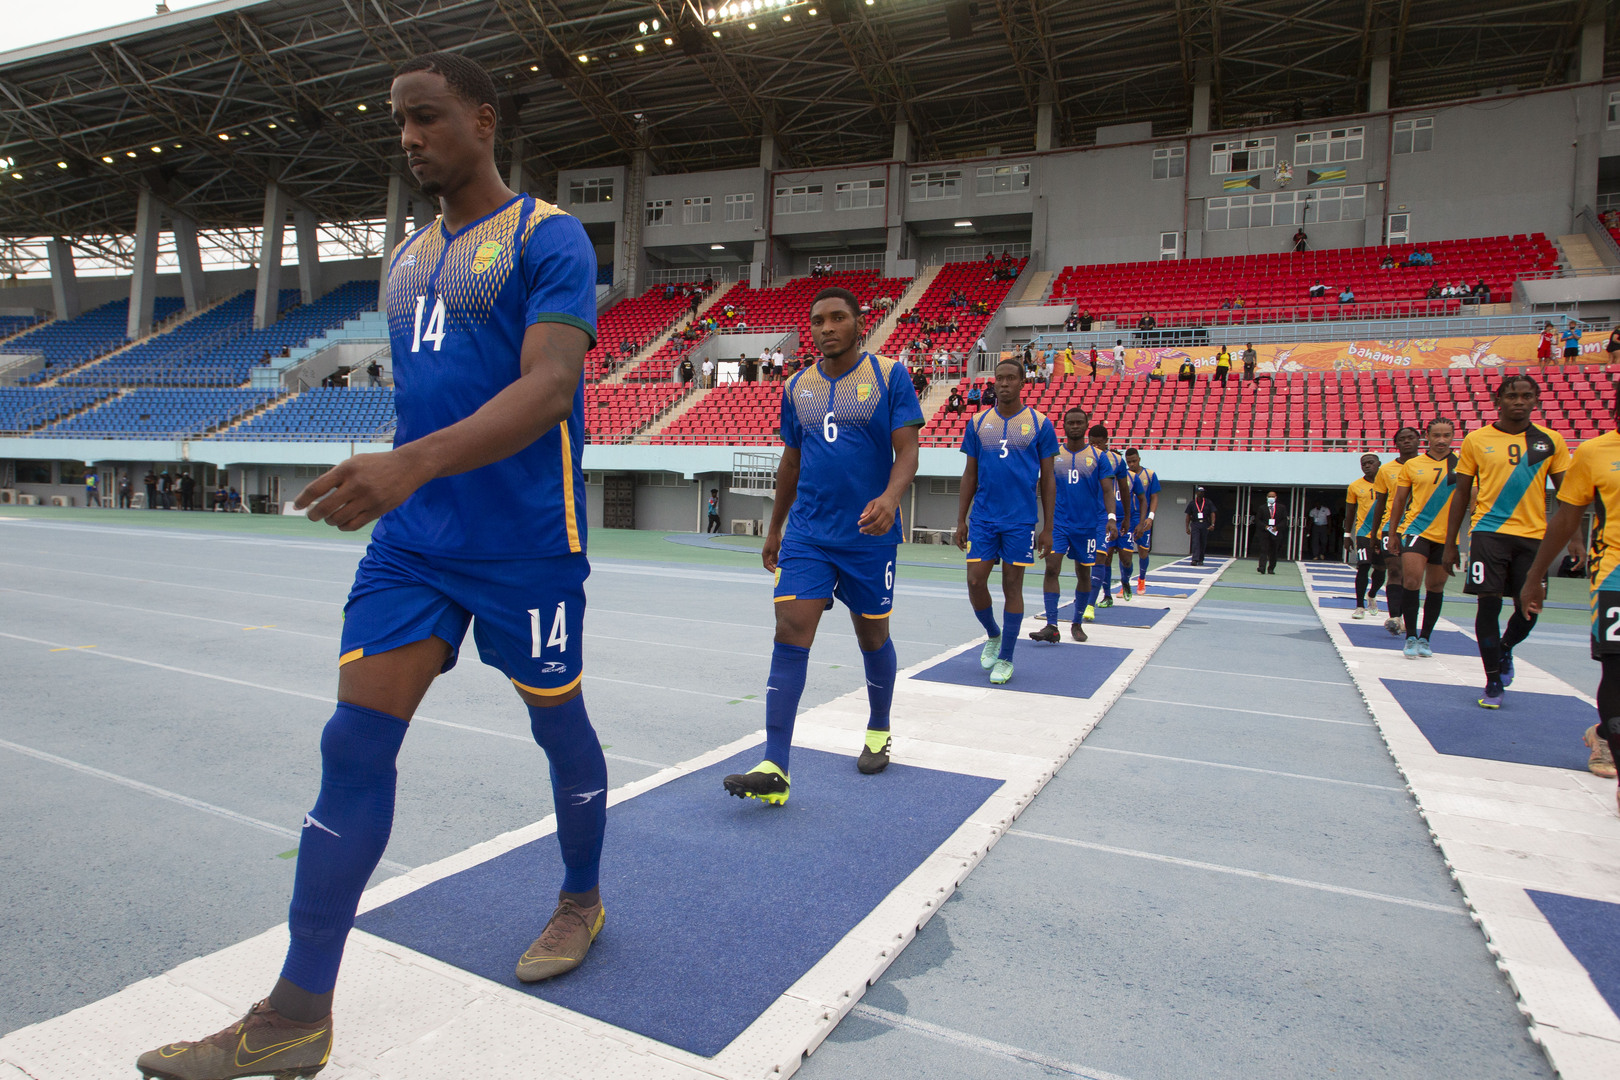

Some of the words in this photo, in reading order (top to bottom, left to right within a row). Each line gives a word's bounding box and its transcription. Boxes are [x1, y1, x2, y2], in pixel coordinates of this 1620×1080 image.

[411, 293, 447, 353] 14
[1184, 349, 1245, 368] ahaas
[1348, 342, 1411, 366] bahamas
[823, 411, 838, 443] 6
[1000, 439, 1009, 459] 3
[1508, 443, 1521, 466] 9
[1068, 469, 1079, 484] 19
[1433, 467, 1443, 485] 7
[1029, 530, 1036, 550] 3
[1086, 538, 1096, 554] 19
[1408, 533, 1420, 547] 7
[1357, 547, 1368, 561] 11
[884, 560, 893, 590] 6
[1472, 561, 1485, 585] 9
[527, 601, 568, 658] 14
[1606, 606, 1620, 642] 2
